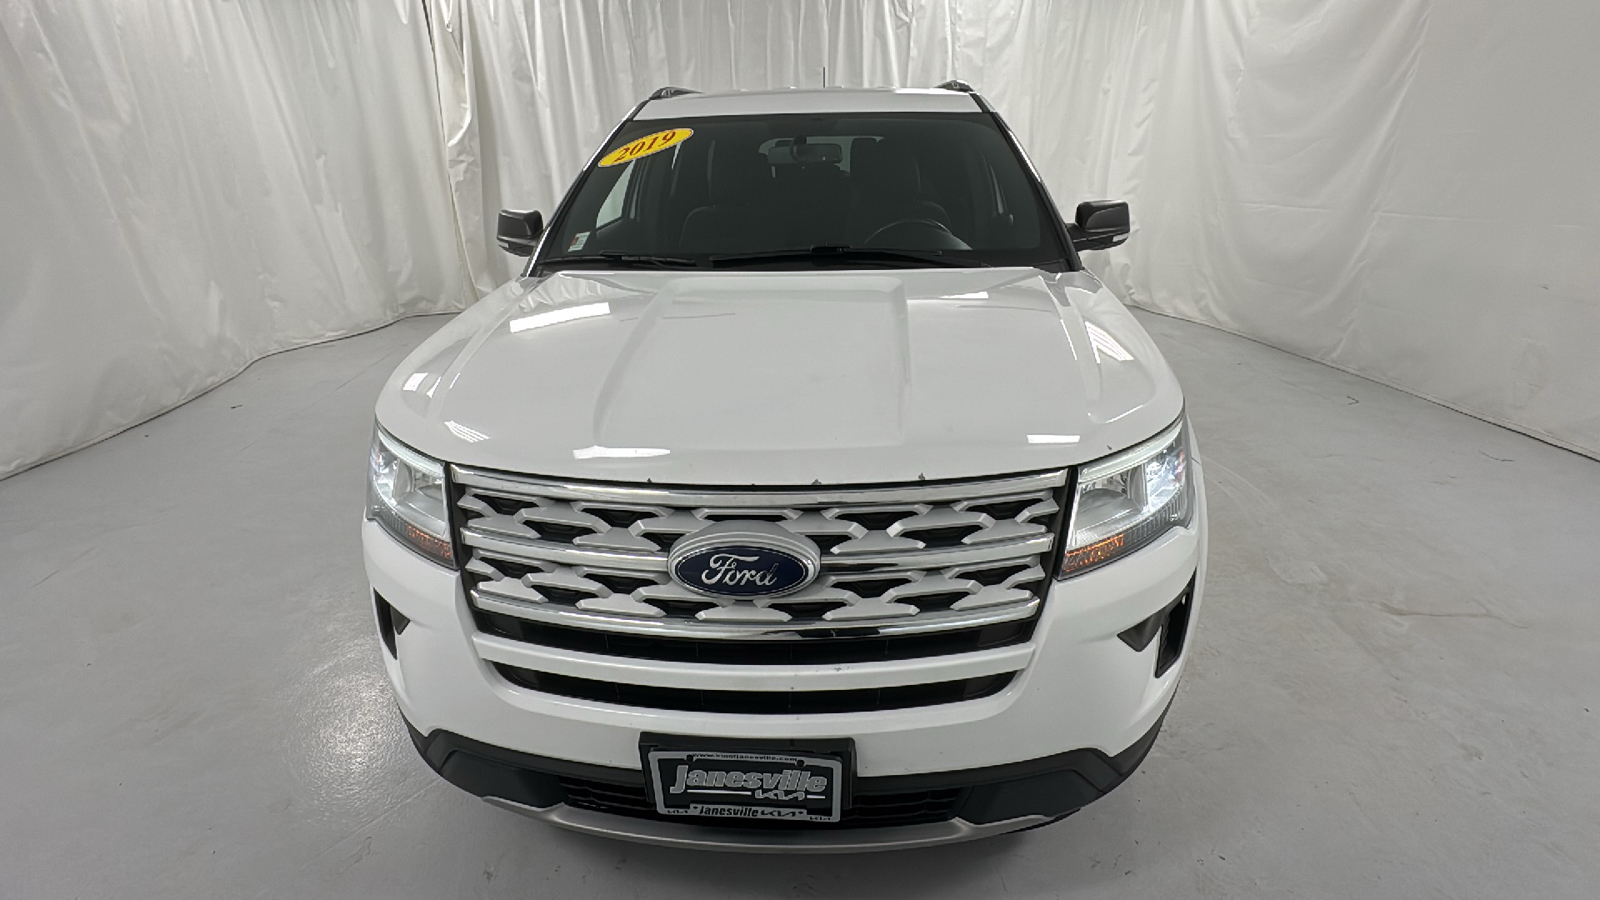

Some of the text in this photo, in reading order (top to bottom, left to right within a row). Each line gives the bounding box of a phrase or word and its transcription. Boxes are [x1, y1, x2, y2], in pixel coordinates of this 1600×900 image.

[613, 131, 676, 163] 2019
[701, 553, 778, 586] Ford
[670, 764, 828, 793] Janesville
[699, 805, 759, 817] Janesville
